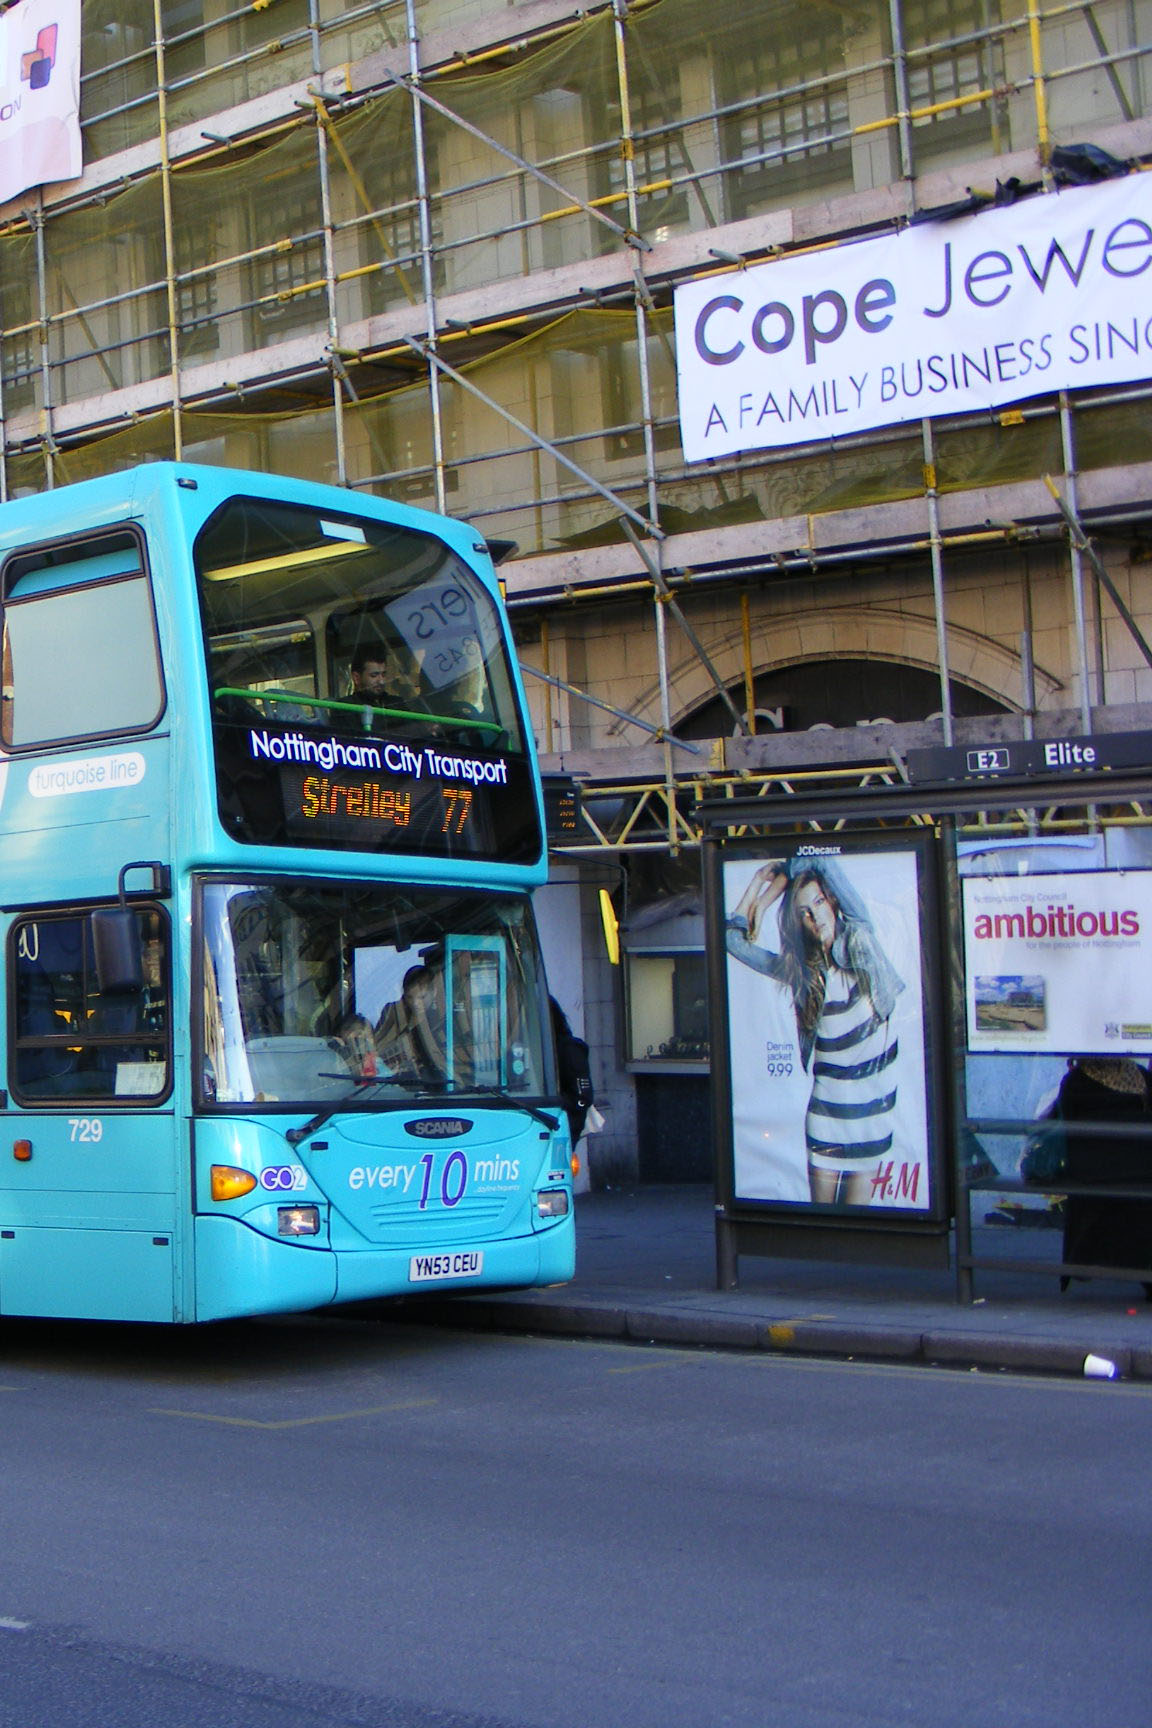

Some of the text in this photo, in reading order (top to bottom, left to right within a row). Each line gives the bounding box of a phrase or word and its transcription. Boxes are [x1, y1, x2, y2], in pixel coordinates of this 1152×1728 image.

[695, 279, 896, 366] Cope
[705, 404, 728, 438] A
[739, 373, 868, 429] FAMILY
[881, 335, 1052, 402] BUSINESS
[251, 730, 507, 785] Nottingham City Transport
[977, 743, 1096, 768] E2 Elite
[35, 759, 138, 789] turquoise line
[301, 776, 473, 833] Strelley 77
[796, 844, 841, 857] JCDecaux
[1037, 892, 1067, 901] Council
[974, 905, 1139, 939] ambitious
[1026, 941, 1036, 949] for
[1038, 941, 1052, 949] the
[1053, 941, 1080, 950] people
[1092, 939, 1140, 949] Nottingham
[766, 1042, 793, 1051] Denim
[767, 1052, 792, 1062] jacket
[767, 1063, 793, 1077] 9.99
[68, 1119, 103, 1142] 729
[415, 1121, 464, 1135] SCANIA
[261, 1166, 306, 1190] GO2
[350, 1151, 519, 1209] every 10 mins
[871, 1160, 921, 1202] H&M
[415, 1254, 478, 1275] YN53 CEU
